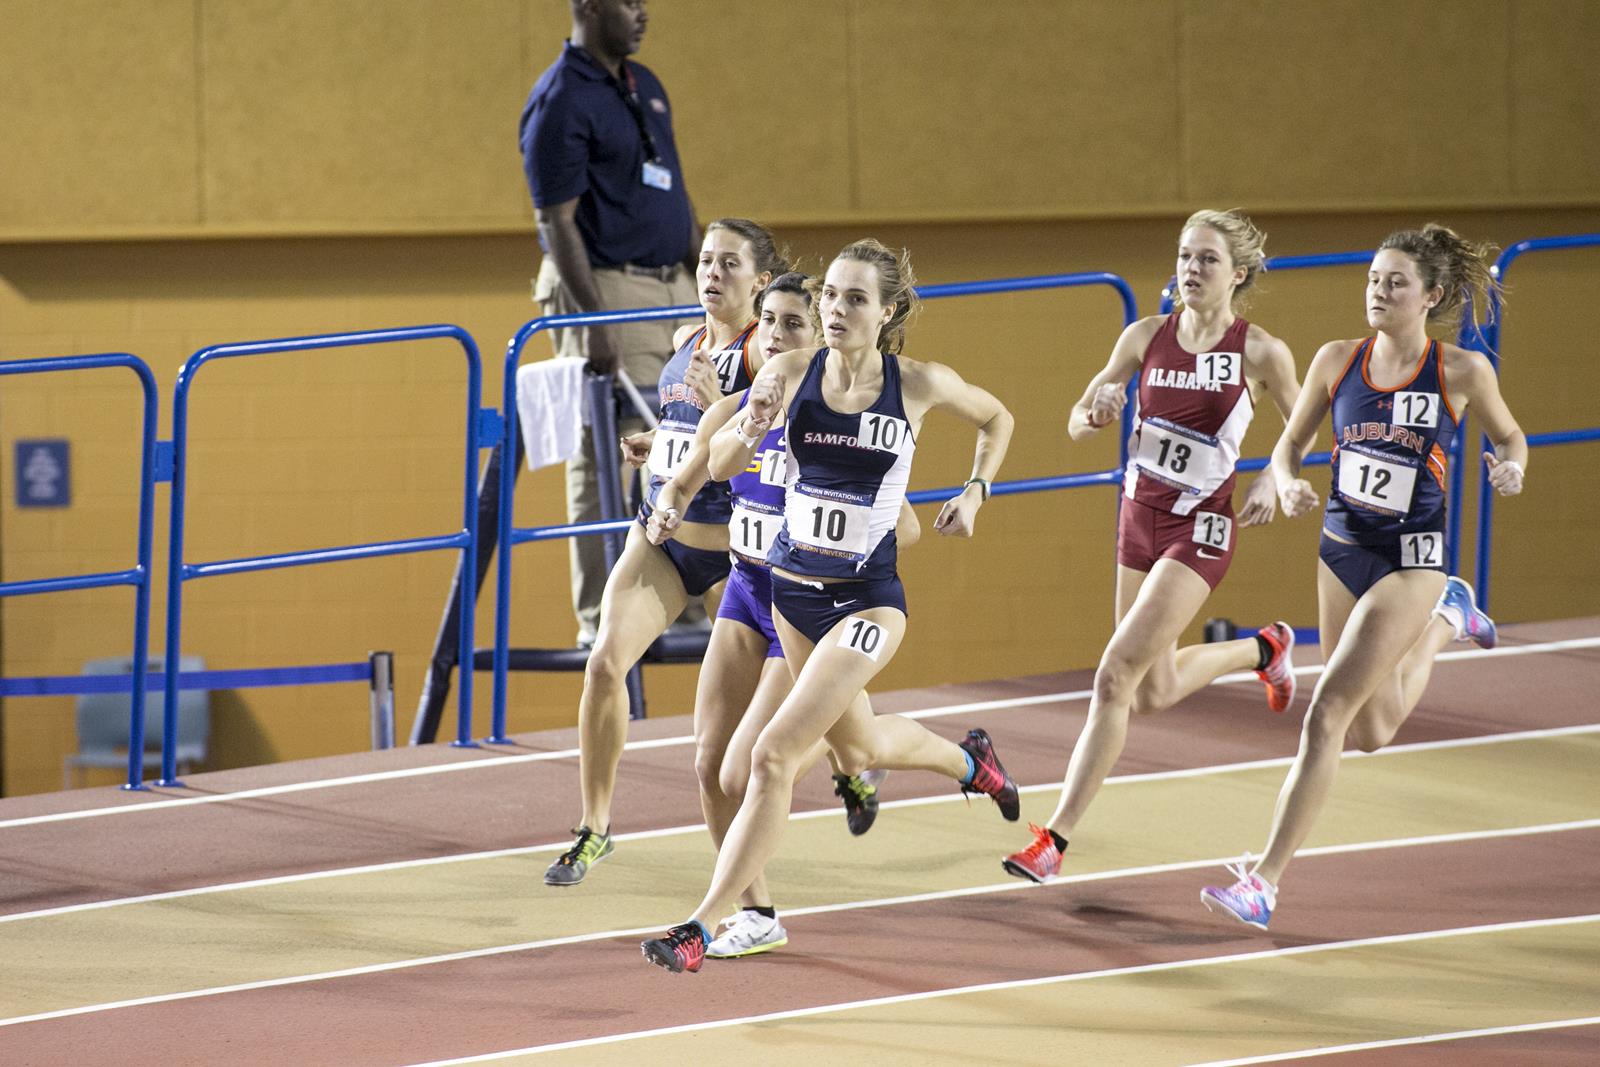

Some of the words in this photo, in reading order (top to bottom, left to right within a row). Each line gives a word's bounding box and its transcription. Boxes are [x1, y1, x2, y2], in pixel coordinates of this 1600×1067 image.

[1204, 354, 1232, 382] 13
[661, 383, 704, 411] AUBUR
[1402, 394, 1430, 425] 12
[804, 432, 880, 452] SAMFO
[869, 415, 898, 450] 10
[1343, 422, 1425, 454] AUBURN
[1157, 438, 1192, 474] 13
[823, 489, 864, 502] INVITATIONAL
[1359, 464, 1392, 500] 12
[741, 516, 762, 551] 11
[812, 506, 847, 542] 10
[1203, 515, 1226, 546] 13
[1408, 534, 1436, 565] 12
[850, 620, 881, 654] 10
